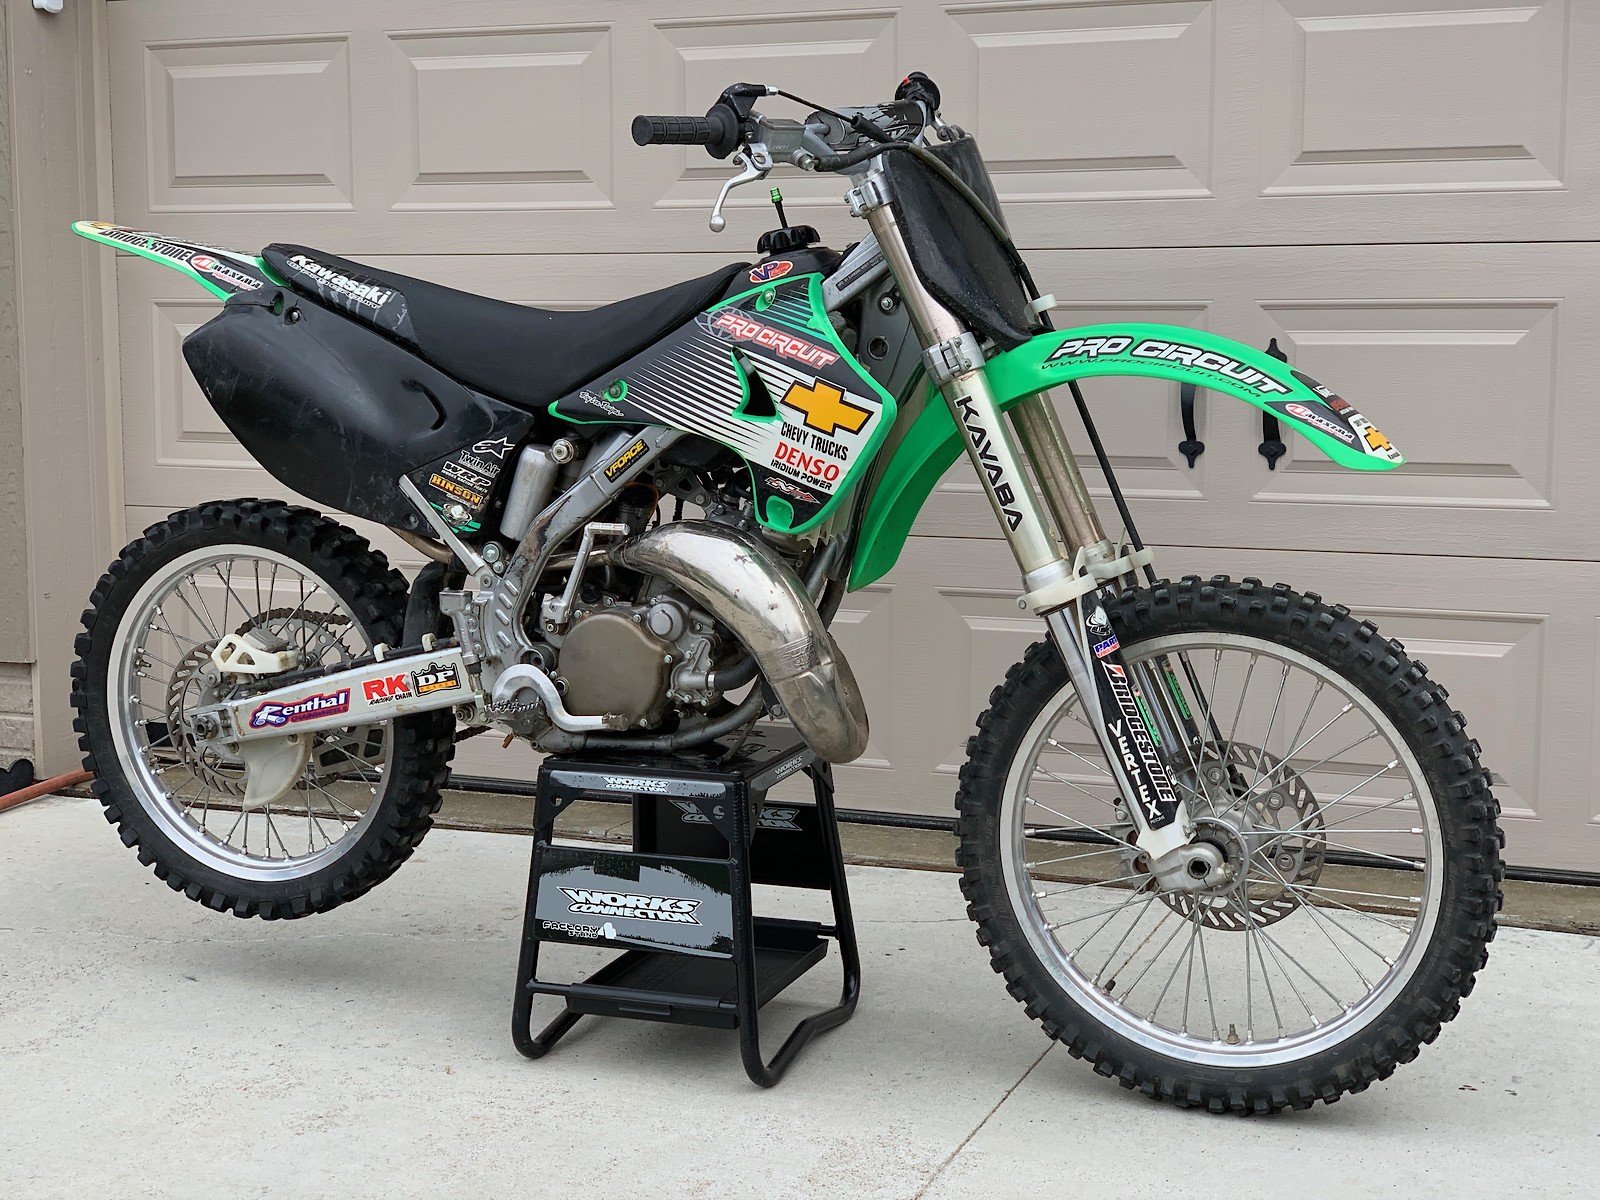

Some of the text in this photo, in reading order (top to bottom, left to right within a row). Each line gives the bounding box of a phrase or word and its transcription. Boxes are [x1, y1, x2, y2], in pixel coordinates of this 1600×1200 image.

[290, 254, 391, 306] Kawasaki
[751, 261, 779, 281] VP
[714, 314, 837, 368] PRO CIRCUIT
[1049, 336, 1291, 395] PRO CIRCUIT
[781, 421, 849, 461] CHEVY TRUCKS
[605, 440, 644, 477] VFORCE
[774, 442, 840, 481] DENSO
[430, 475, 481, 504] HINSON
[771, 459, 800, 478] IRIDIUM
[801, 472, 833, 491] POWER
[362, 674, 410, 700] RK
[417, 670, 454, 686] DP
[395, 691, 412, 701] CHAIN
[1101, 661, 1177, 802] BRIDGESTONE
[602, 776, 671, 788] WORKS
[1108, 719, 1163, 819] VERTEX
[558, 887, 702, 913] WORKS
[568, 902, 702, 926] CONNECTION
[542, 921, 599, 934] FACTORY
